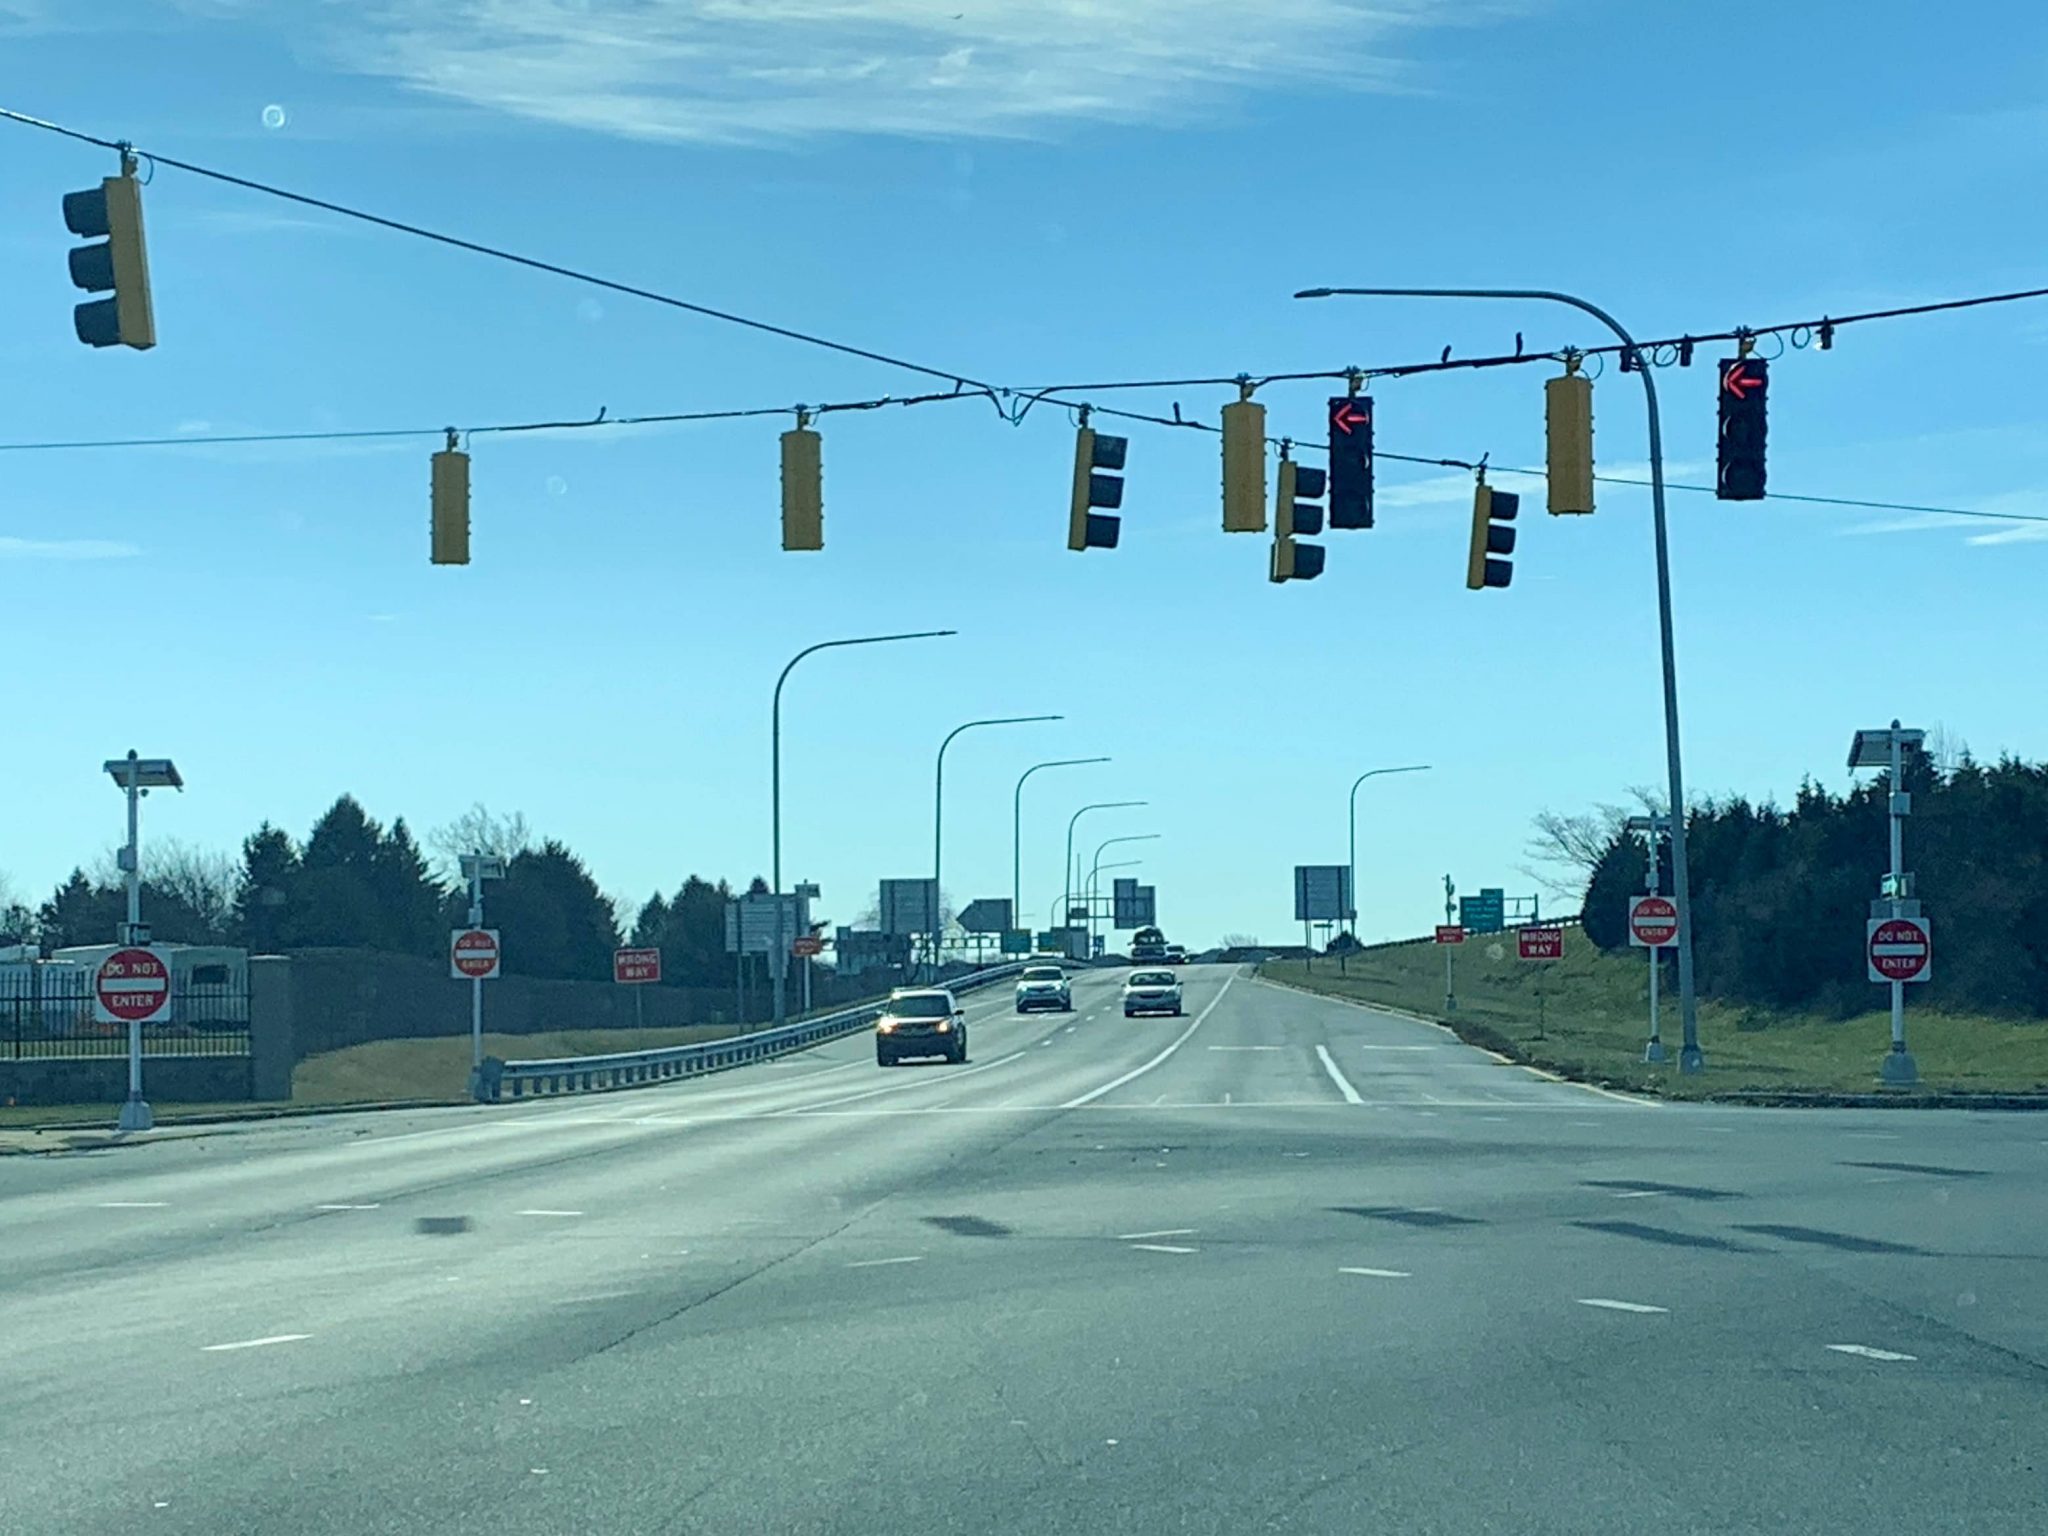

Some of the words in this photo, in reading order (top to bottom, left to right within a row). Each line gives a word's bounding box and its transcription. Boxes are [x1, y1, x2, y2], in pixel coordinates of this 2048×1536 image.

[1521, 931, 1560, 942] WRONG
[1878, 930, 1893, 941] DO
[1897, 930, 1918, 941] NOT
[1528, 944, 1552, 955] WAY
[106, 961, 125, 975] DO
[132, 962, 158, 974] NOT
[1882, 958, 1916, 969] ENTER
[625, 967, 649, 977] WAY
[112, 994, 154, 1007] ENTER
